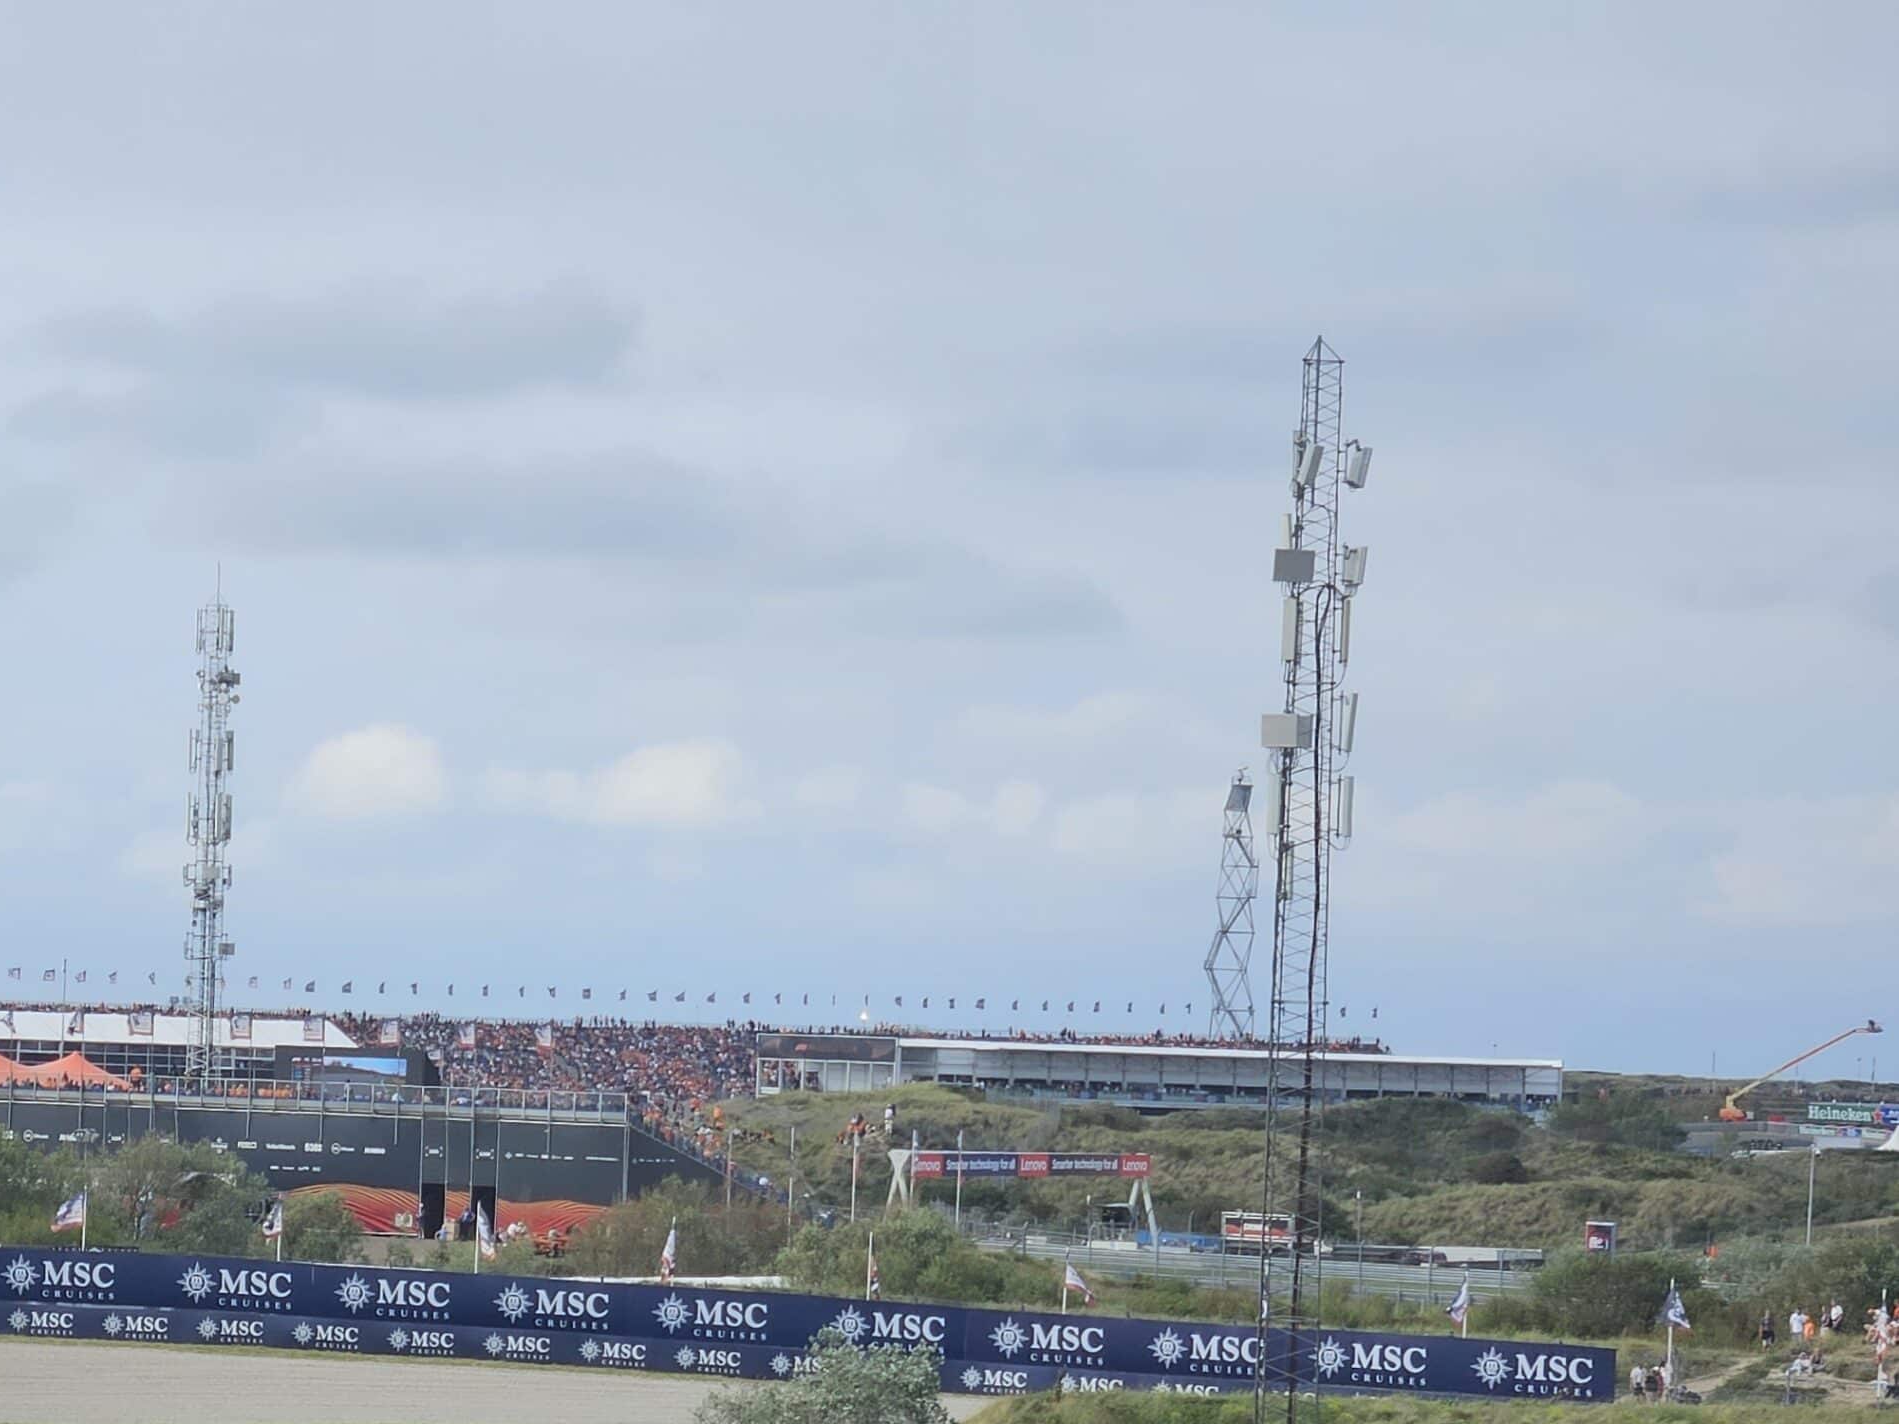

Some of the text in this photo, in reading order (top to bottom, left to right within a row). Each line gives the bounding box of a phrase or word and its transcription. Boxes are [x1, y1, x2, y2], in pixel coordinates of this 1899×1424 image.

[1808, 1106, 1872, 1121] Heineken
[42, 1261, 115, 1288] MSC
[218, 1268, 292, 1297] MSC
[42, 1288, 115, 1300] CRUISES
[376, 1279, 450, 1307] MSC
[218, 1298, 292, 1310] CRUISES
[535, 1289, 609, 1318] MSC
[30, 1311, 74, 1329] MSC
[376, 1307, 449, 1320] CRUISES
[694, 1299, 768, 1329] MSC
[125, 1315, 168, 1333] MSC
[220, 1319, 264, 1337] MSC
[534, 1318, 608, 1330] CRUISES
[872, 1311, 945, 1341] MSC
[315, 1324, 359, 1343] MSC
[410, 1330, 454, 1348] MSC
[693, 1328, 767, 1341] CRUISES
[1030, 1323, 1104, 1352] MSC
[506, 1335, 551, 1353] MSC
[602, 1342, 647, 1360] MSC
[1190, 1334, 1263, 1363] MSC
[697, 1349, 741, 1366] MSC
[793, 1355, 823, 1373] MS
[1030, 1353, 1104, 1366] CRUISES
[1351, 1343, 1427, 1373] MSC
[1514, 1353, 1593, 1384] MSC
[983, 1369, 1027, 1388] MSC
[1351, 1373, 1427, 1386] CRUISES
[1514, 1383, 1593, 1398] CRUISES
